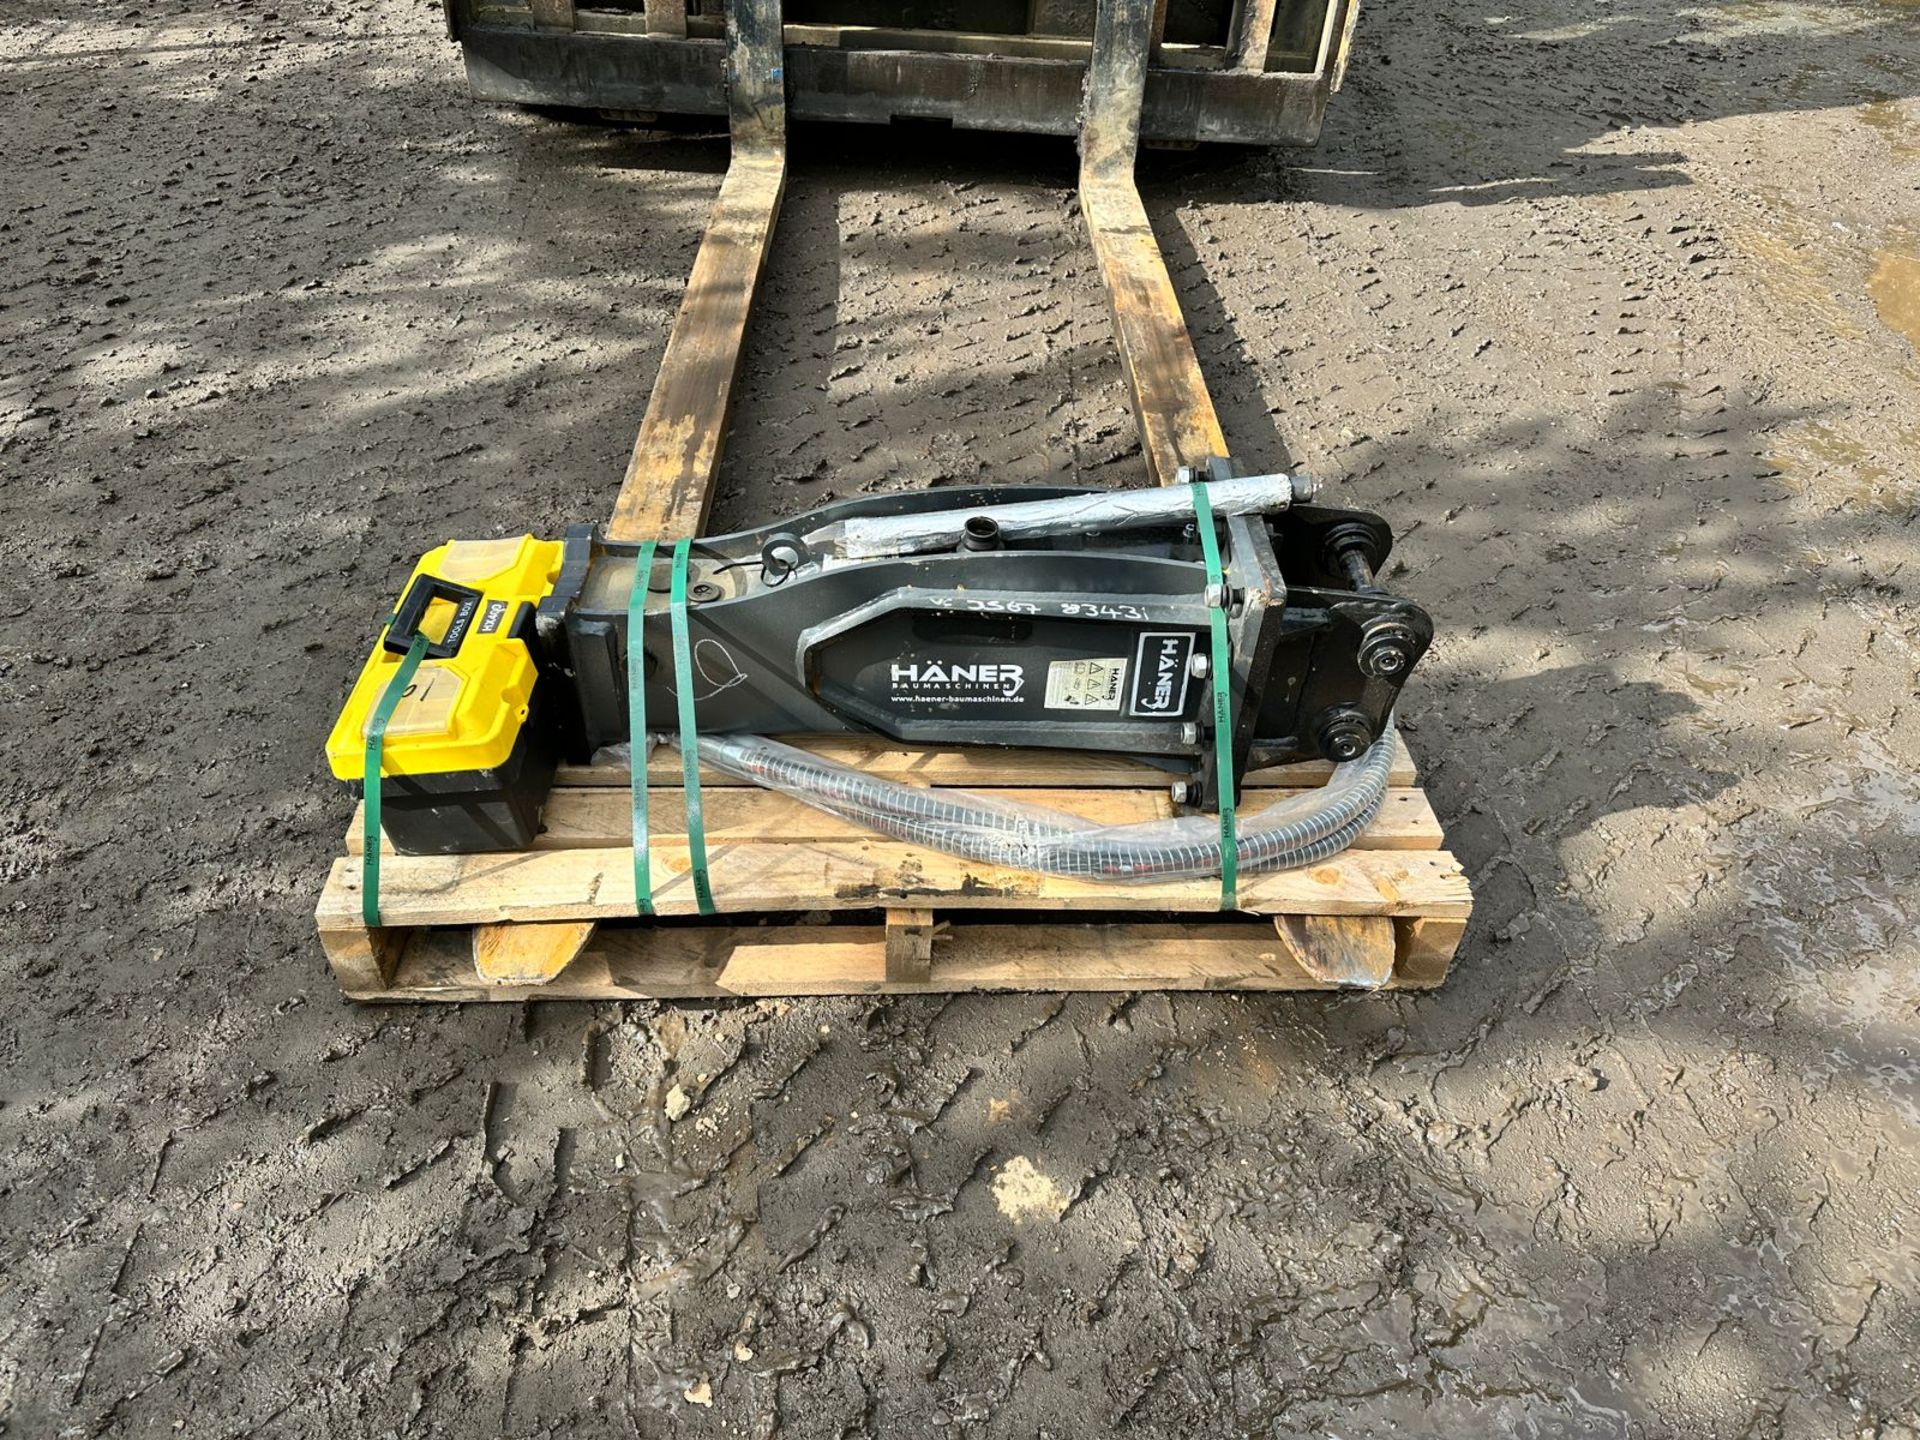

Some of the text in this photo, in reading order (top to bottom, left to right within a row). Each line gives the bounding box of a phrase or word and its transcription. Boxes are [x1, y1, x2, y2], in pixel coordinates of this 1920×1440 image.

[460, 601, 473, 617] BOX
[890, 660, 1025, 697] HÄNER
[1140, 639, 1179, 709] HÄNER
[892, 682, 1011, 690] BAUMASCHINEN
[890, 694, 1025, 704] www.haener-baumaschinen.de
